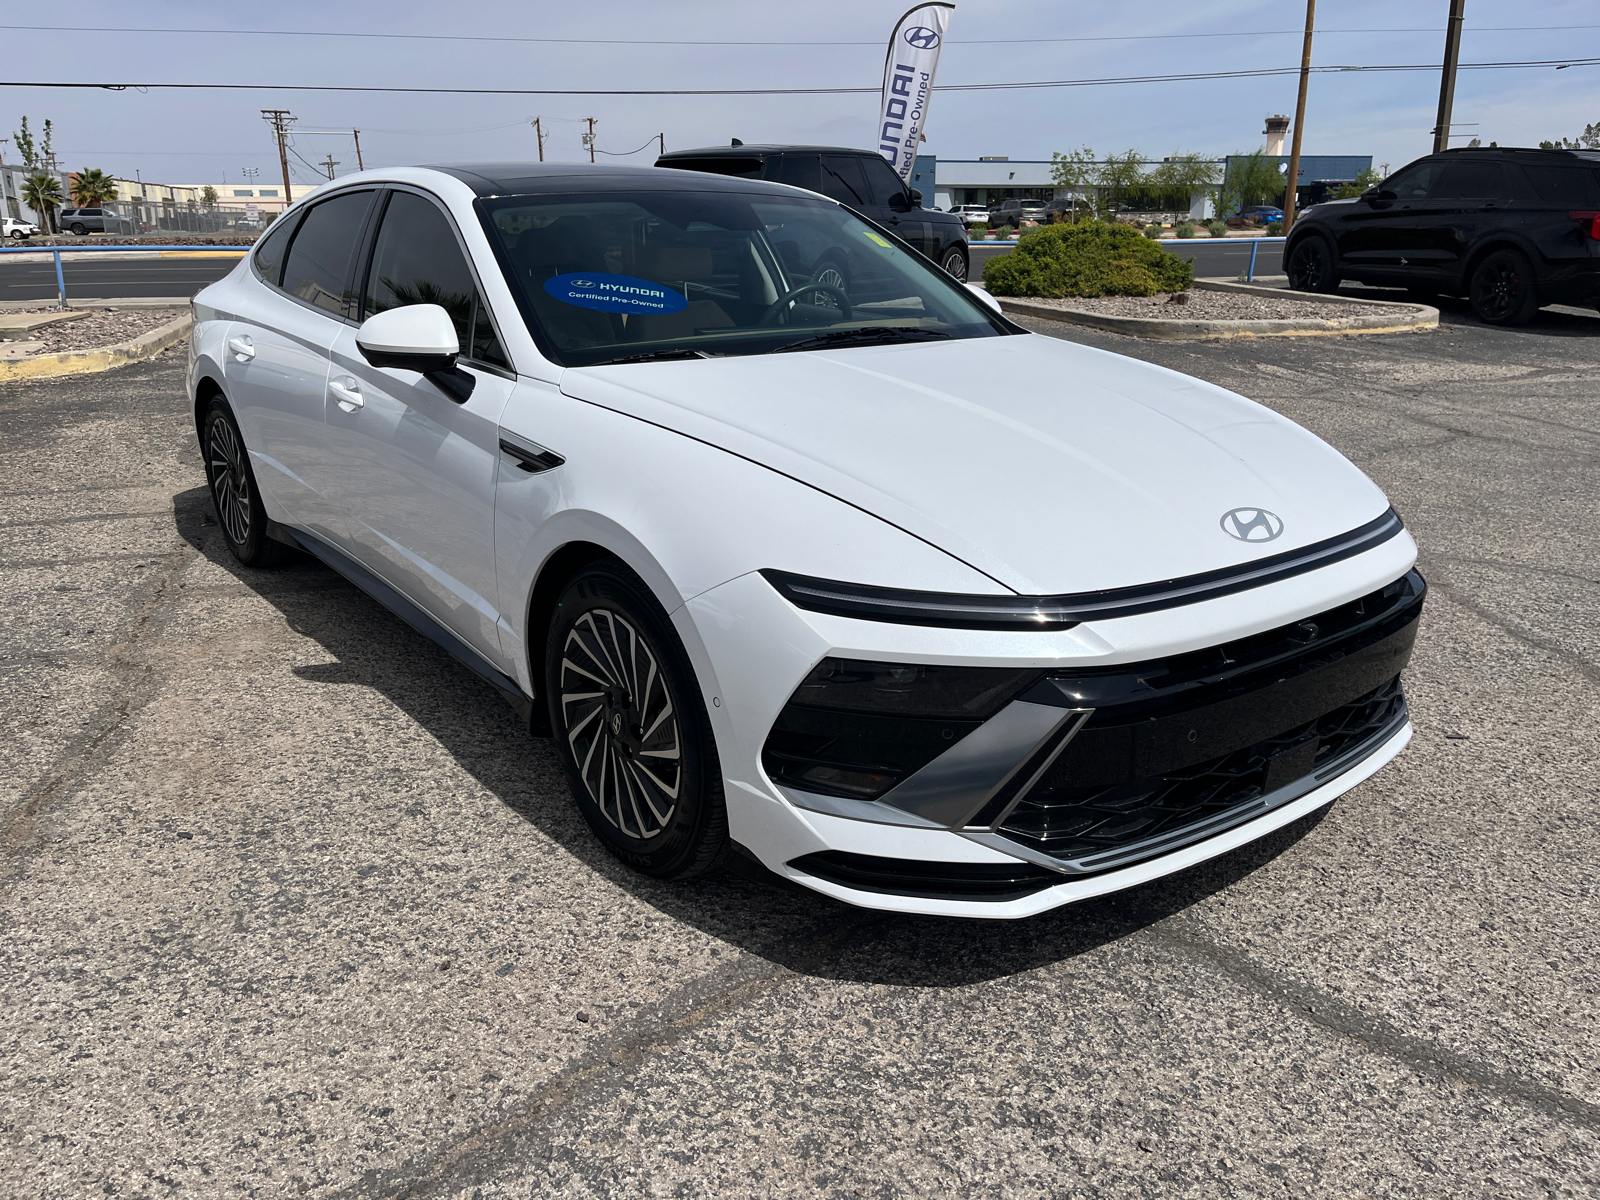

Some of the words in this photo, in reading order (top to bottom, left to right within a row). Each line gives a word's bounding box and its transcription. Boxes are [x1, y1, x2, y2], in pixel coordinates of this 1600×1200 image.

[880, 64, 916, 167] UNDAI
[905, 72, 930, 149] Pre-Owned
[568, 291, 610, 301] Certified
[611, 296, 664, 309] Pre-Owned
[600, 282, 664, 298] HYUNDAI
